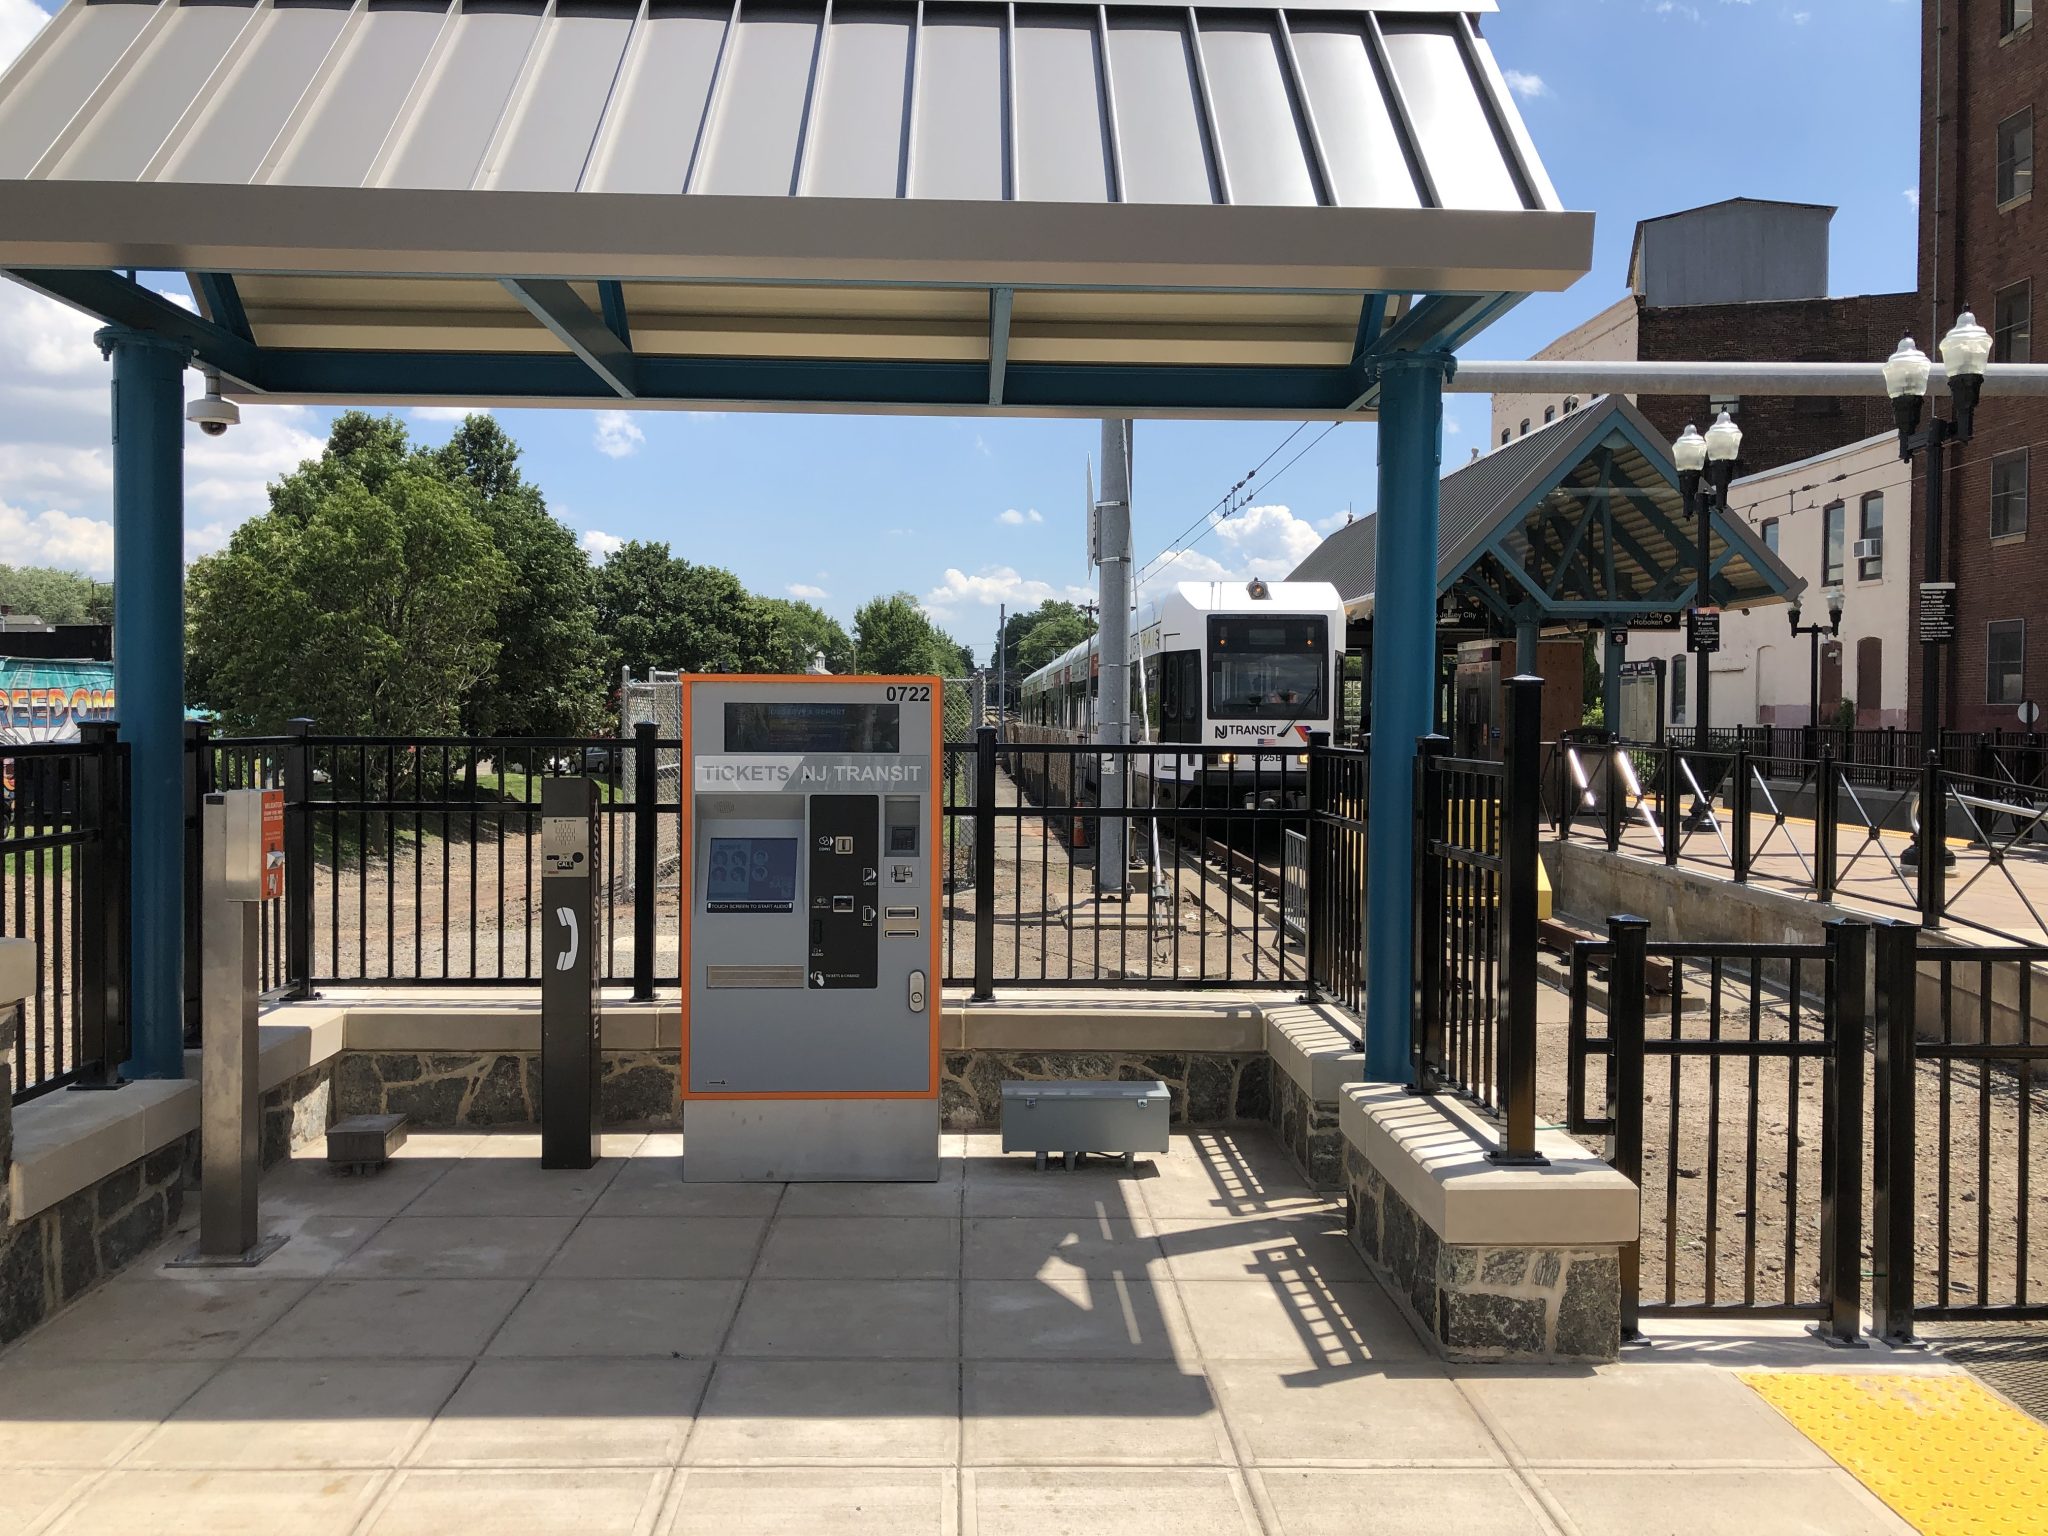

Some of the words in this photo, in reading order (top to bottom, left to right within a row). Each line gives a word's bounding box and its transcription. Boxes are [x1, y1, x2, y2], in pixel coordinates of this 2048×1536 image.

[1440, 611, 1462, 619] Jesey
[1463, 611, 1477, 620] City
[1649, 611, 1663, 620] City
[886, 686, 930, 702] 0722
[1215, 725, 1228, 739] NJ
[1229, 725, 1277, 735] TRANSIT
[702, 765, 790, 782] TICKETS
[802, 765, 827, 782] NJ
[834, 765, 922, 782] TRANSIT
